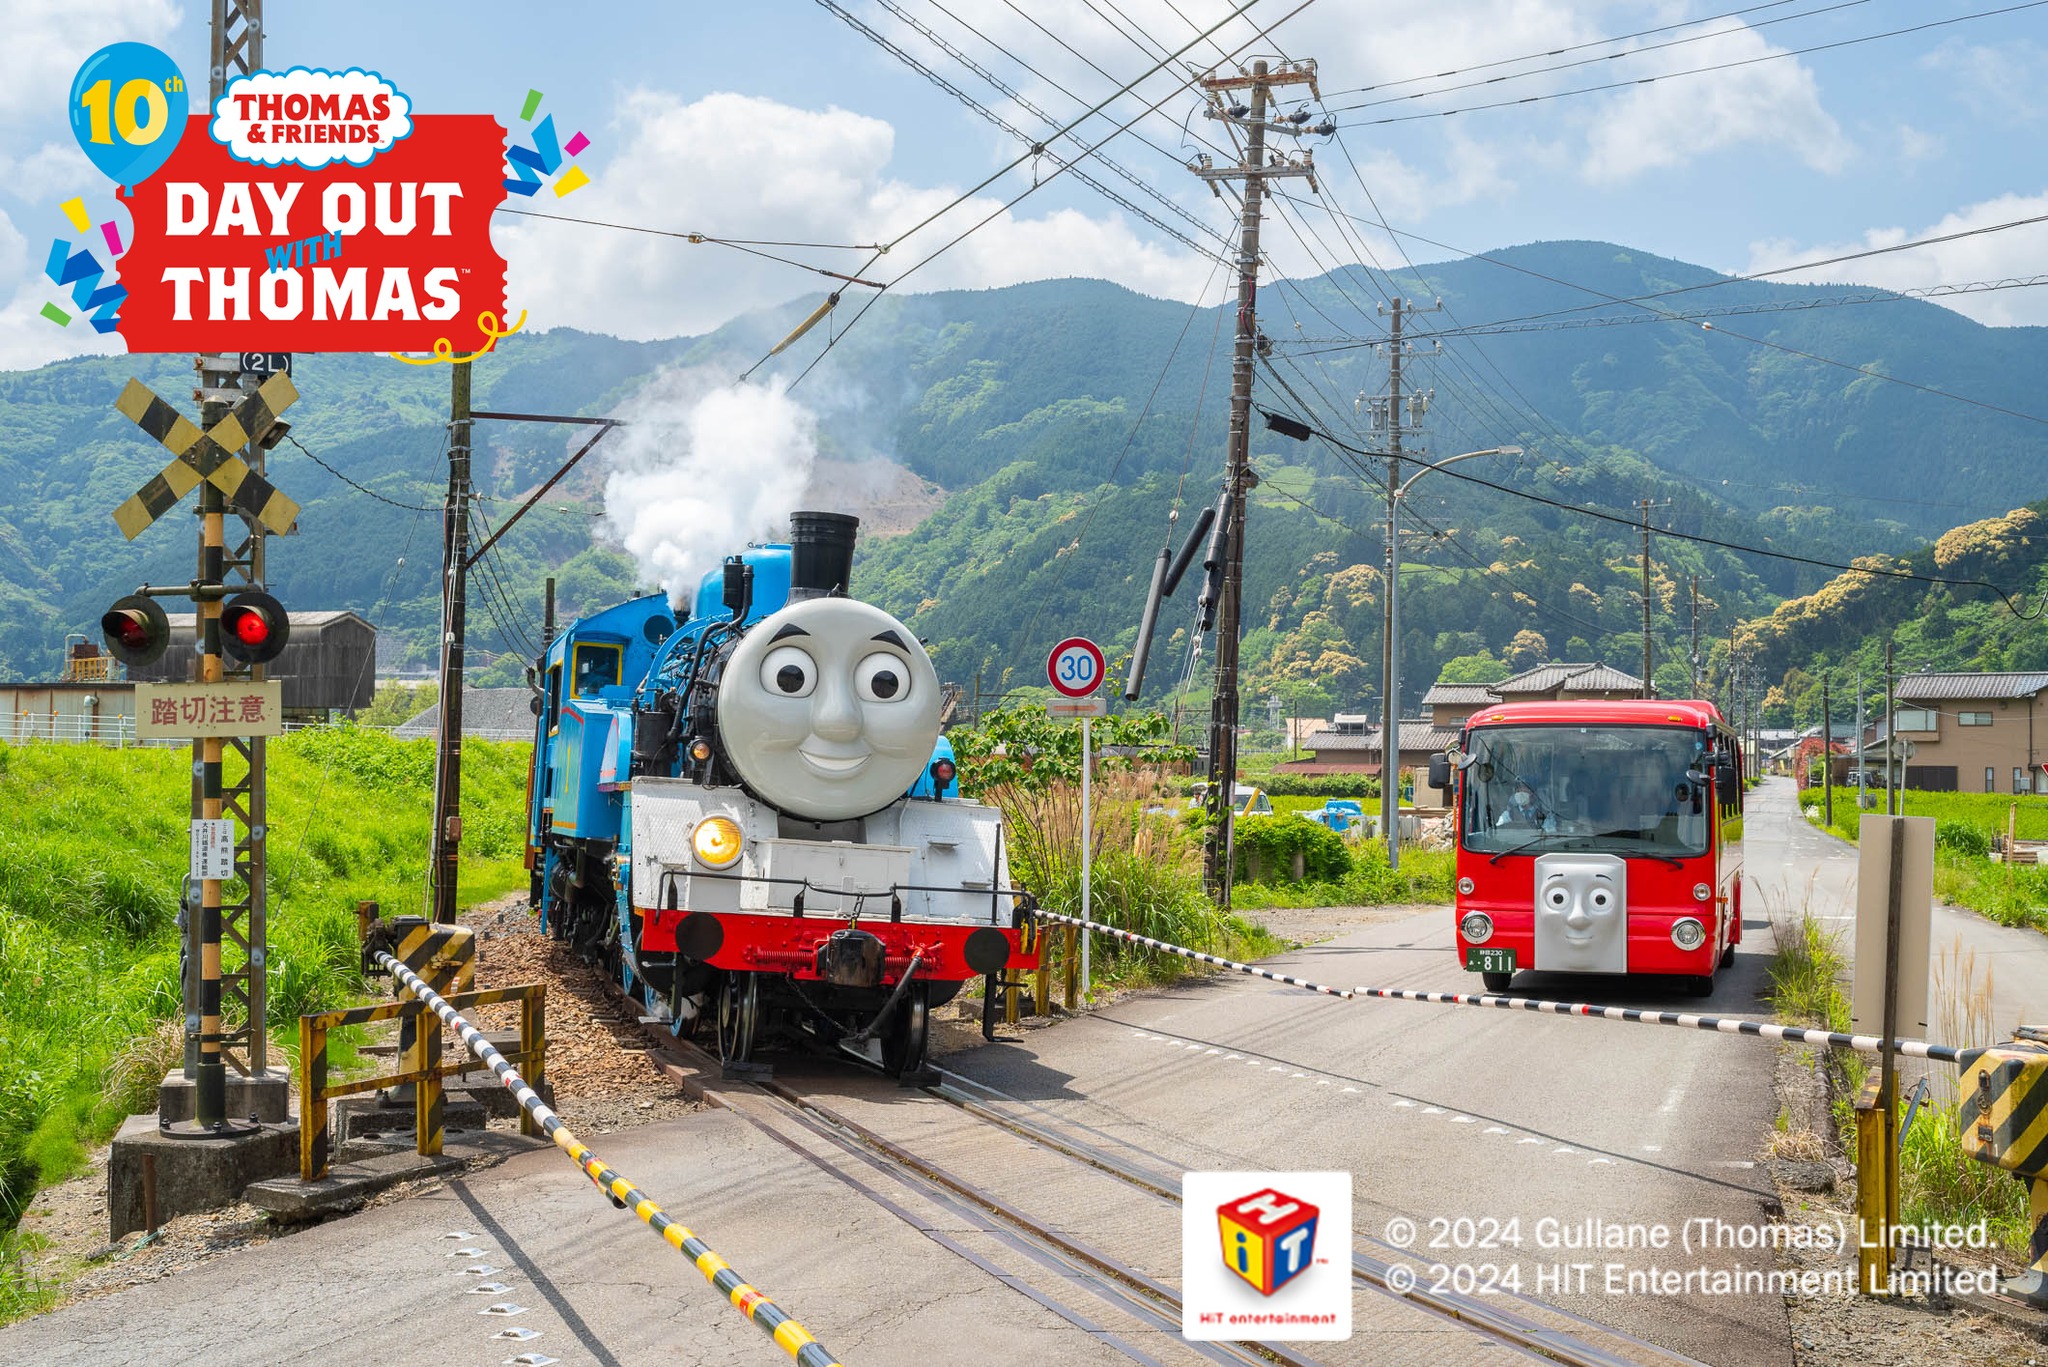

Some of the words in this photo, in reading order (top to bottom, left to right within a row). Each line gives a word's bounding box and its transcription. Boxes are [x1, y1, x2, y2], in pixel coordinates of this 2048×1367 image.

[1061, 655, 1093, 681] 30
[151, 695, 266, 726] 踏切注意
